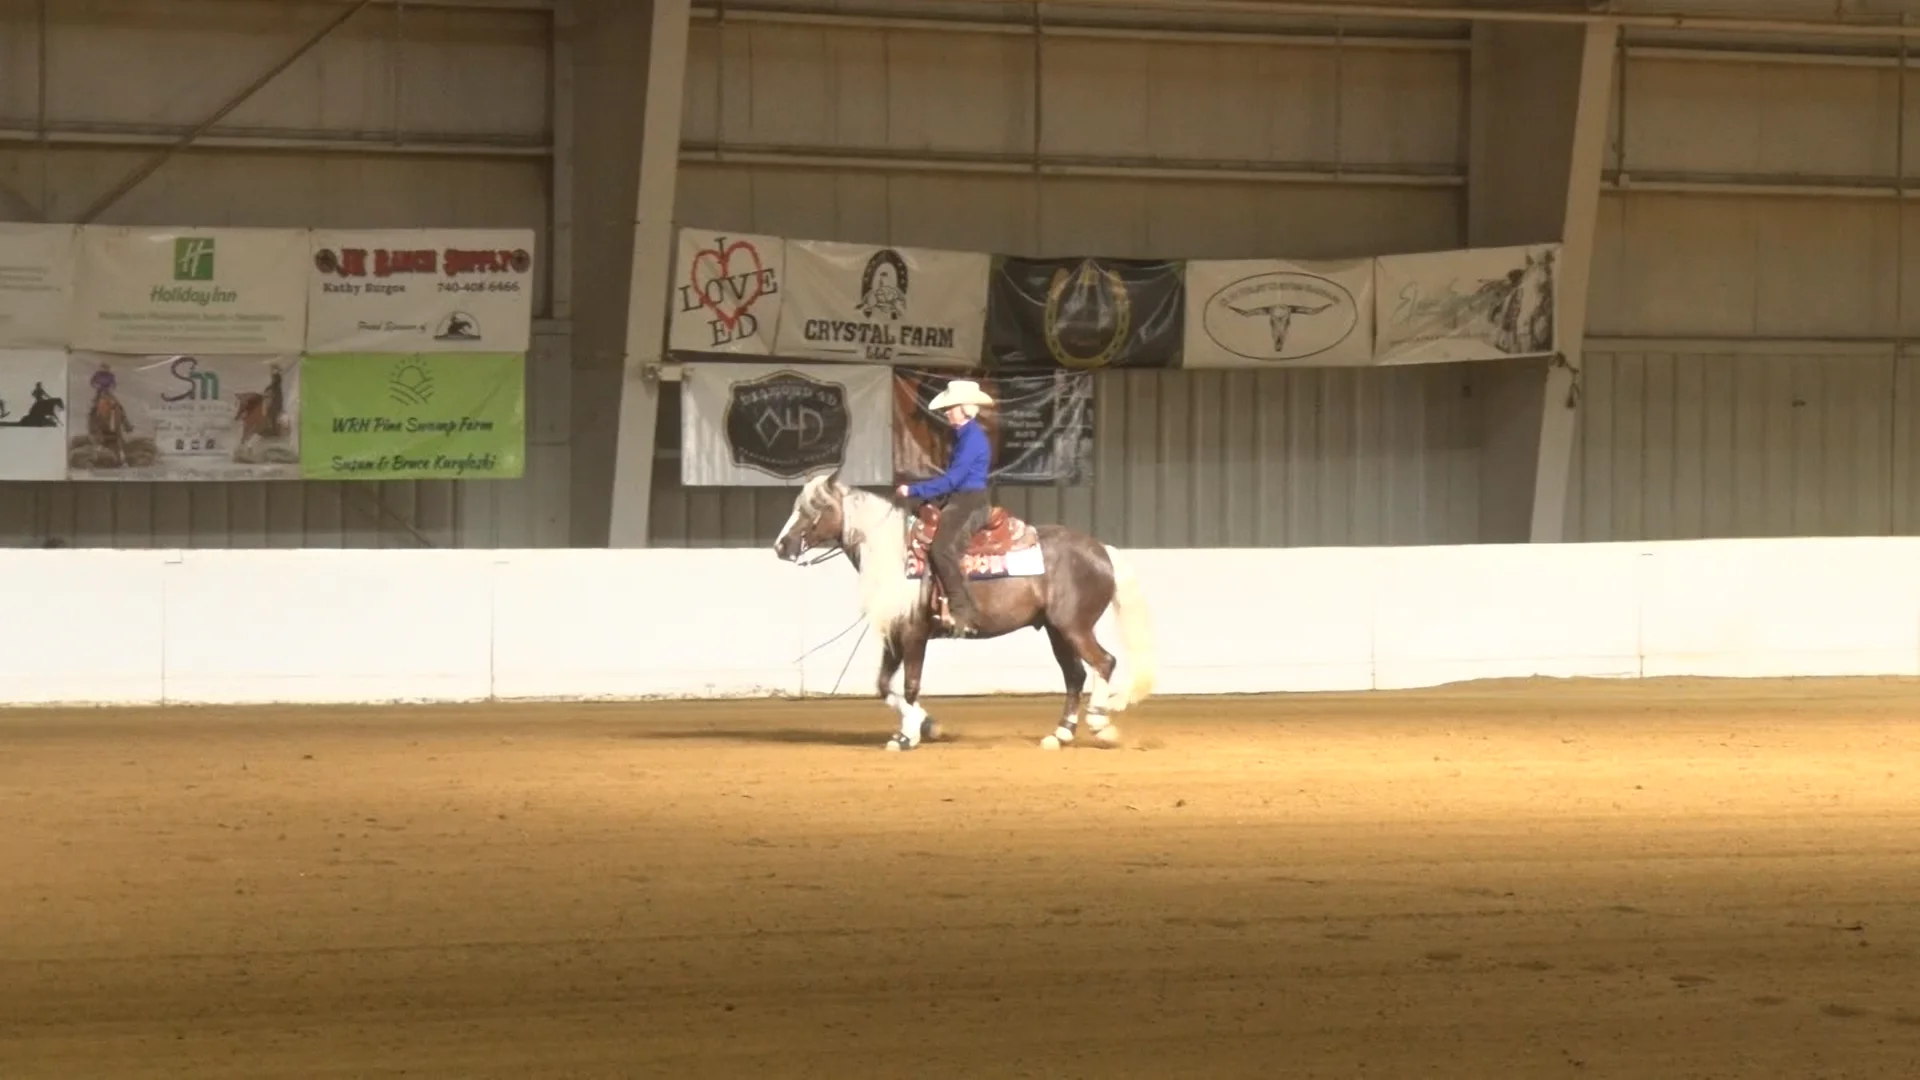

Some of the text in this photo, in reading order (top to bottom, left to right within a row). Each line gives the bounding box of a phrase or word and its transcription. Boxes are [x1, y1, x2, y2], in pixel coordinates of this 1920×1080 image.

[150, 285, 237, 306] Holiday Inn
[679, 268, 778, 312] LOVE
[708, 313, 758, 347] ED
[804, 319, 954, 348] CRYSTAL FARM
[866, 345, 893, 360] LLC
[459, 416, 493, 433] Farm
